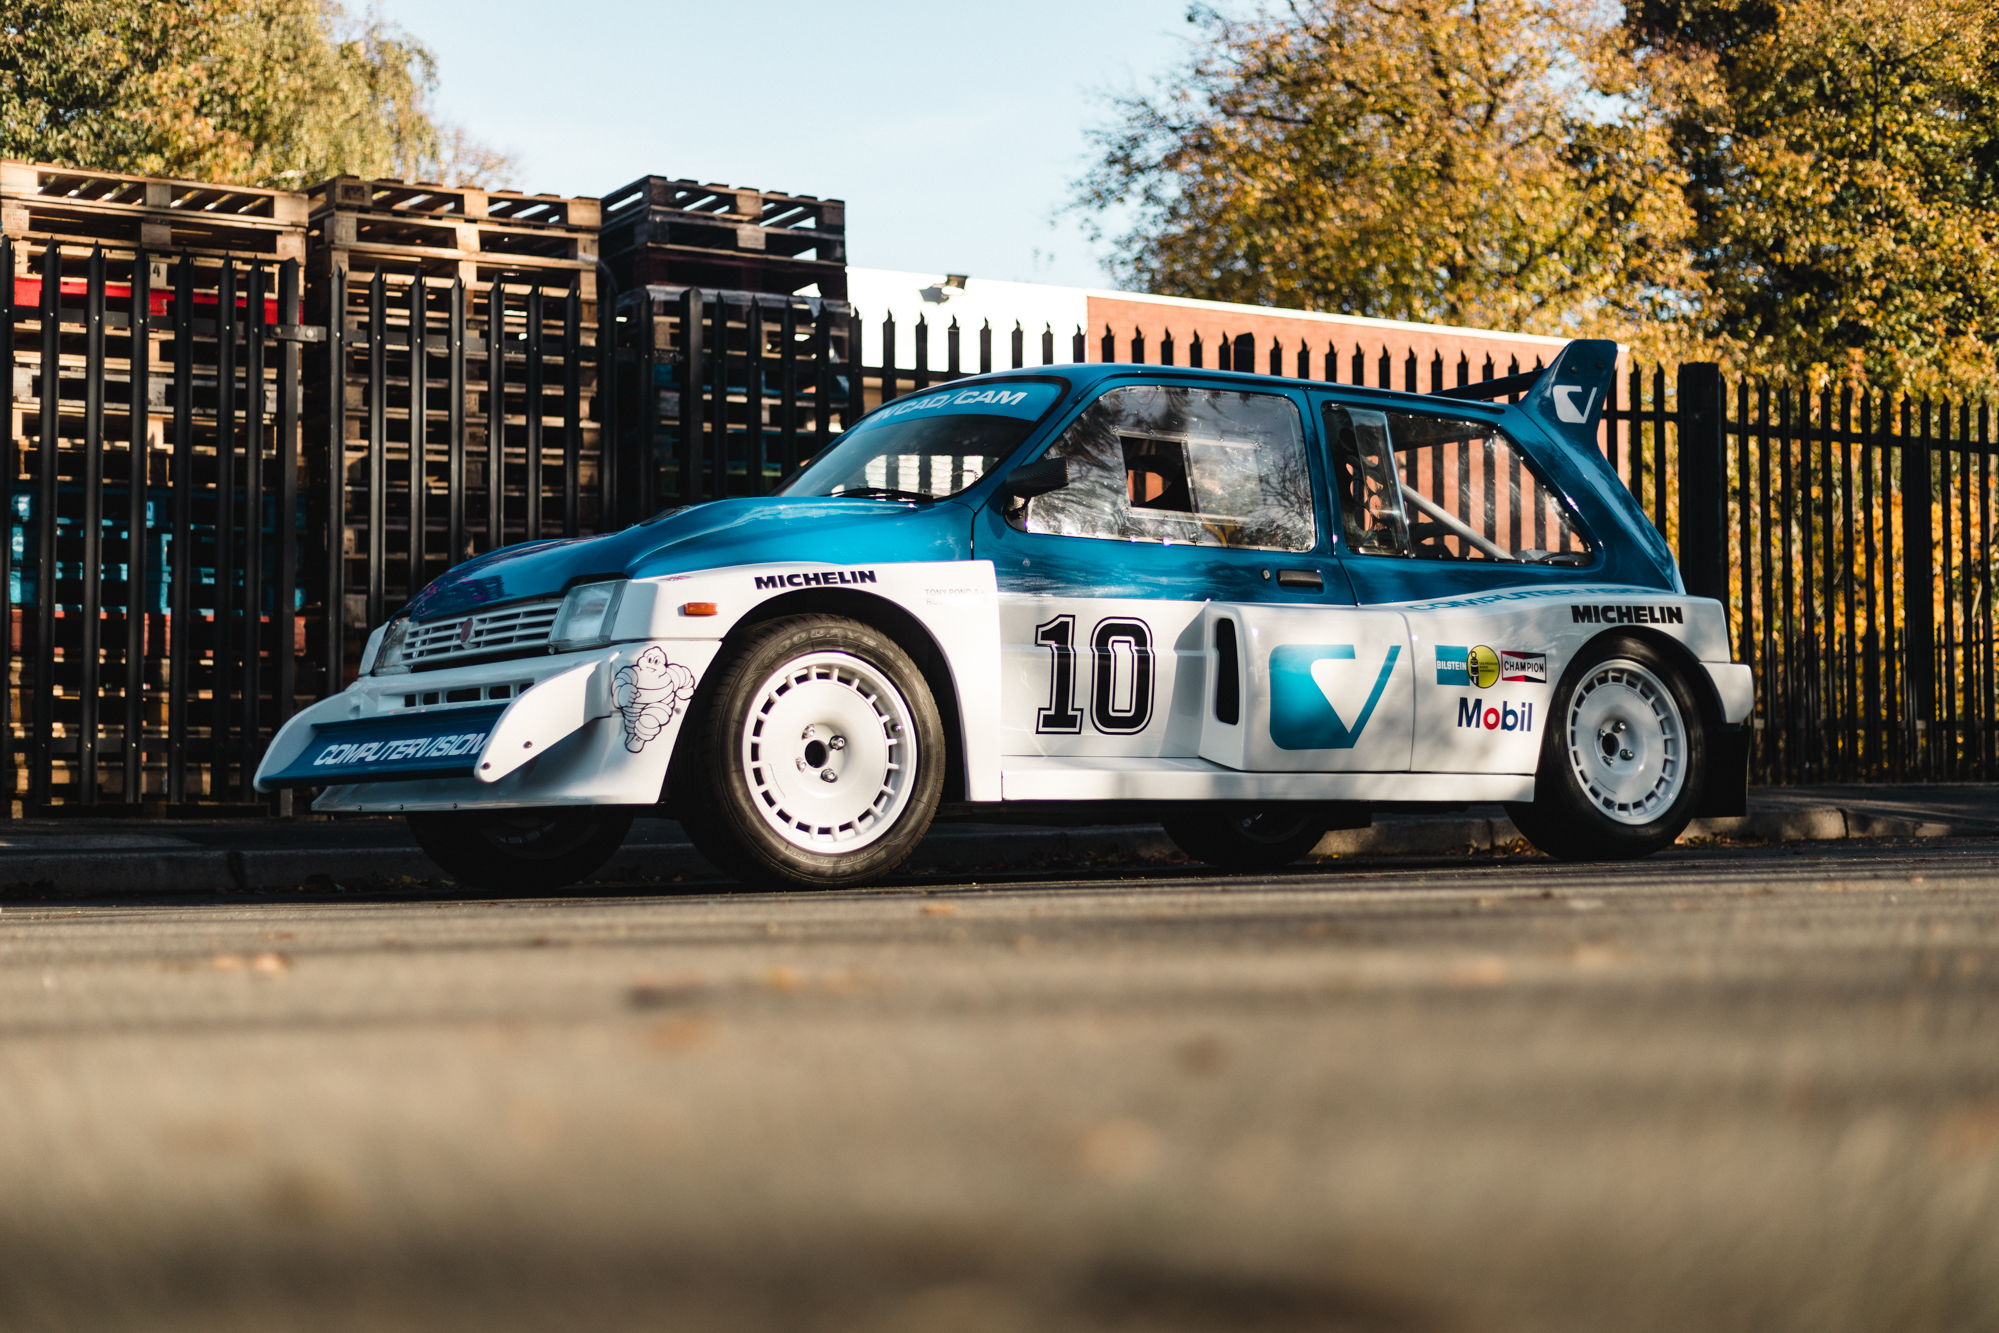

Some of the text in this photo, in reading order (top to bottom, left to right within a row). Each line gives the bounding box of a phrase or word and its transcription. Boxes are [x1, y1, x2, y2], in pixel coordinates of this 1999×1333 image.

[894, 390, 1028, 416] CAD/CAM
[754, 570, 877, 590] MICHELIN
[925, 588, 947, 597] TONY
[1571, 605, 1683, 624] MICHELIN
[1035, 614, 1155, 735] 10
[1436, 660, 1467, 671] BILSTEIN
[1503, 660, 1544, 674] CHAMPION
[1457, 697, 1533, 732] Mobil
[313, 733, 488, 766] COMPUTERVISION
